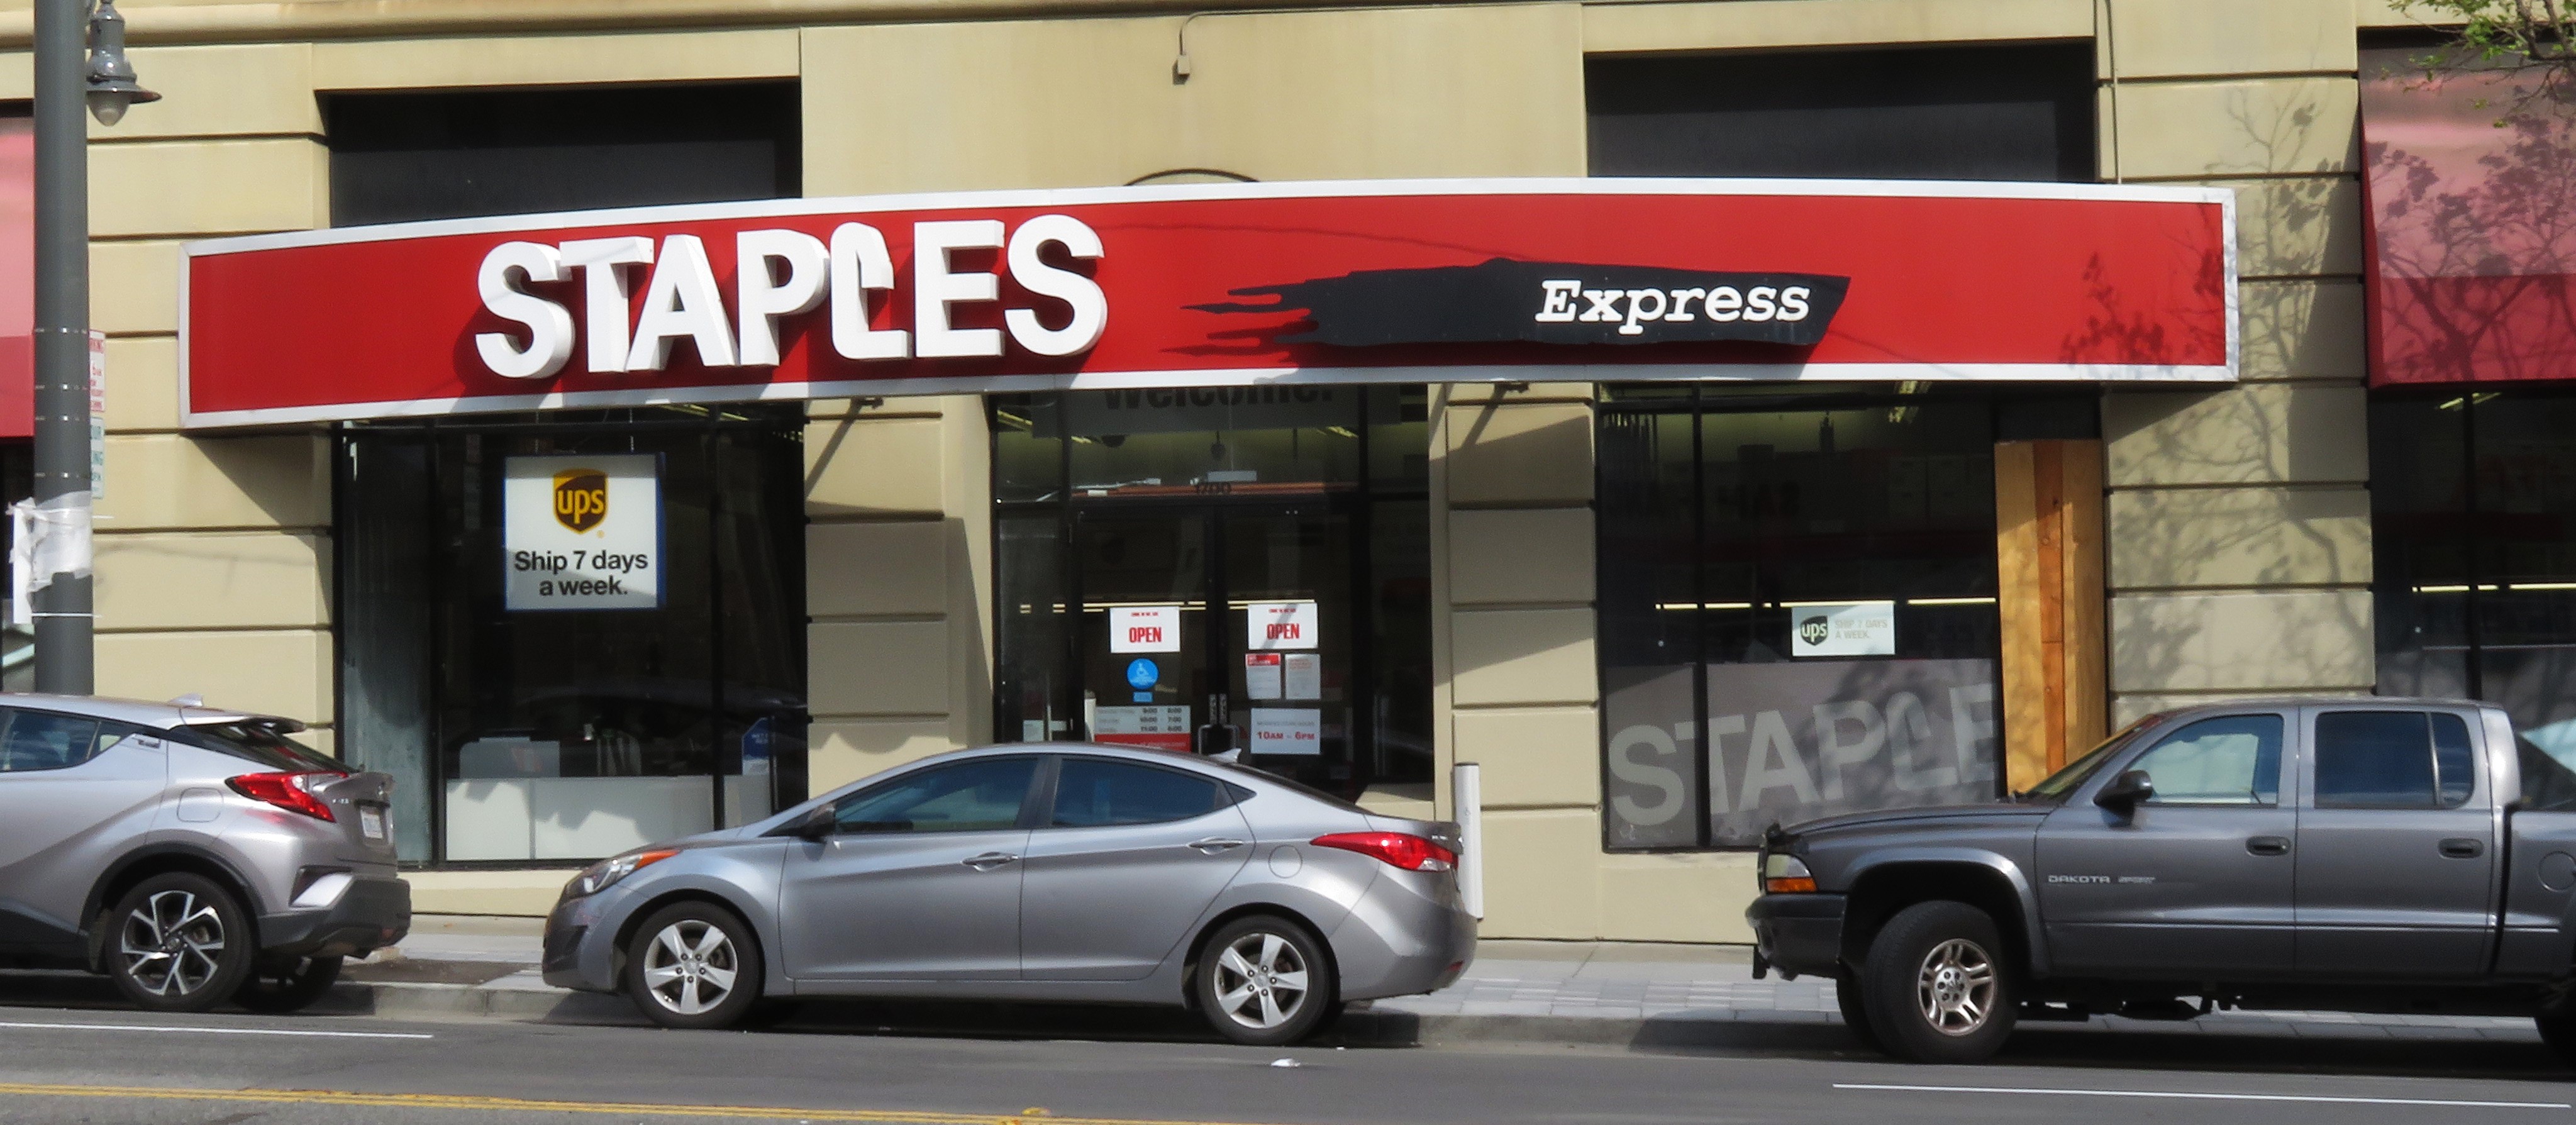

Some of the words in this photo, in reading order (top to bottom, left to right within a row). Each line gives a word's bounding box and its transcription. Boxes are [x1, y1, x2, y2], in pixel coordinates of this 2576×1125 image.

[475, 214, 1109, 379] STAPLES
[1535, 279, 1811, 335] Express
[557, 489, 605, 524] ups
[514, 550, 567, 575] Ship
[573, 550, 586, 570] 7
[592, 549, 648, 574] days
[539, 579, 554, 596] a
[558, 575, 628, 596] week.
[1267, 623, 1300, 640] OPEN
[1802, 623, 1828, 642] ups
[1835, 620, 1854, 628] SHIP
[1865, 619, 1887, 628] DAYS
[1128, 626, 1162, 643] OPEN
[1835, 631, 1841, 639] A
[1258, 731, 1284, 740] 10AM
[2048, 875, 2111, 884] DAKOTA
